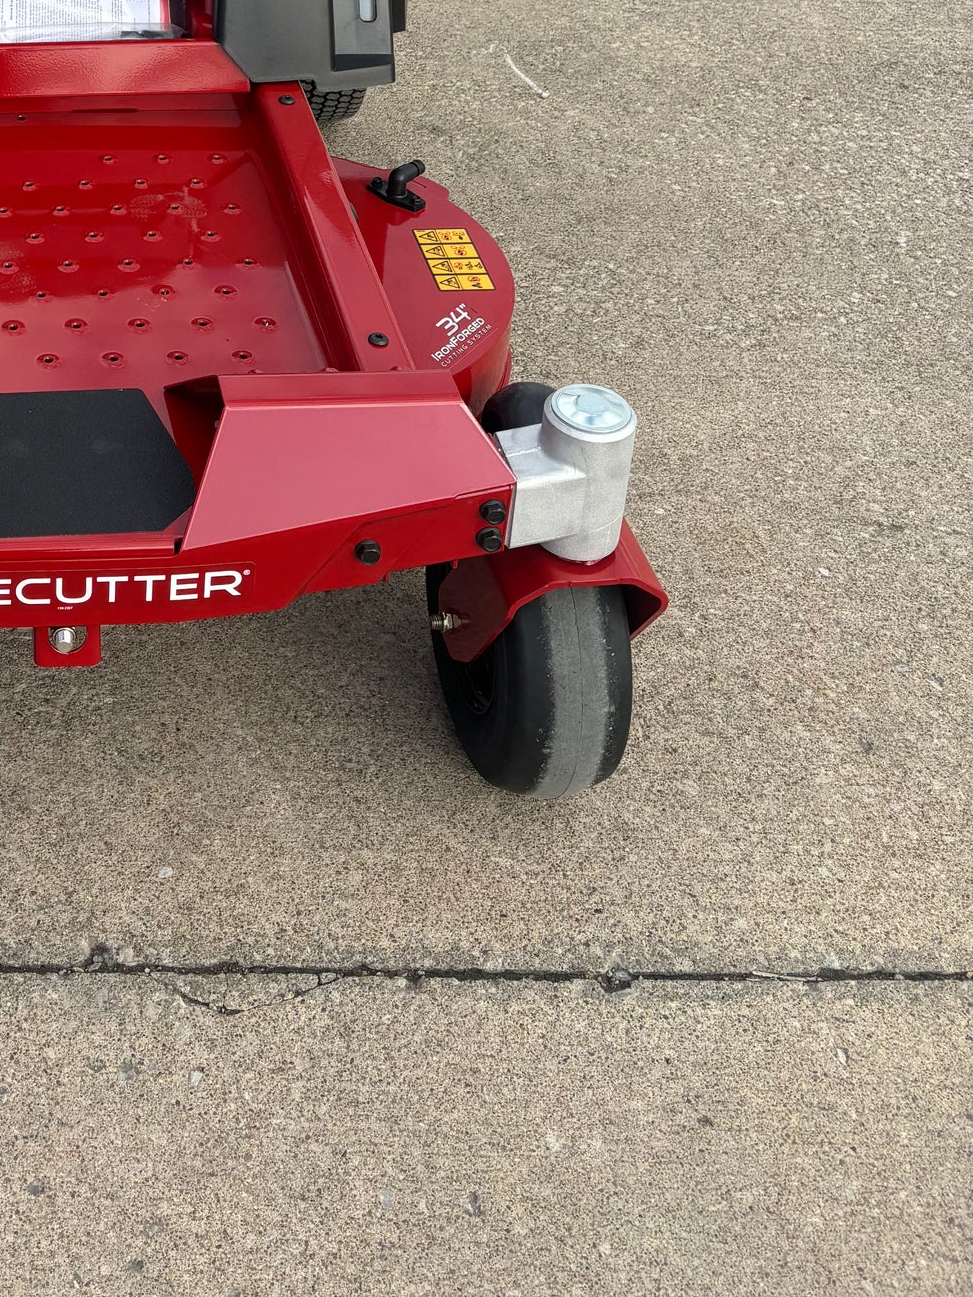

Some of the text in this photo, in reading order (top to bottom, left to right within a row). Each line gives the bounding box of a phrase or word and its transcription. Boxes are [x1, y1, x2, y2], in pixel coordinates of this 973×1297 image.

[431, 317, 485, 361] IRONFORGED
[441, 324, 492, 367] CUTTING SYSTEM
